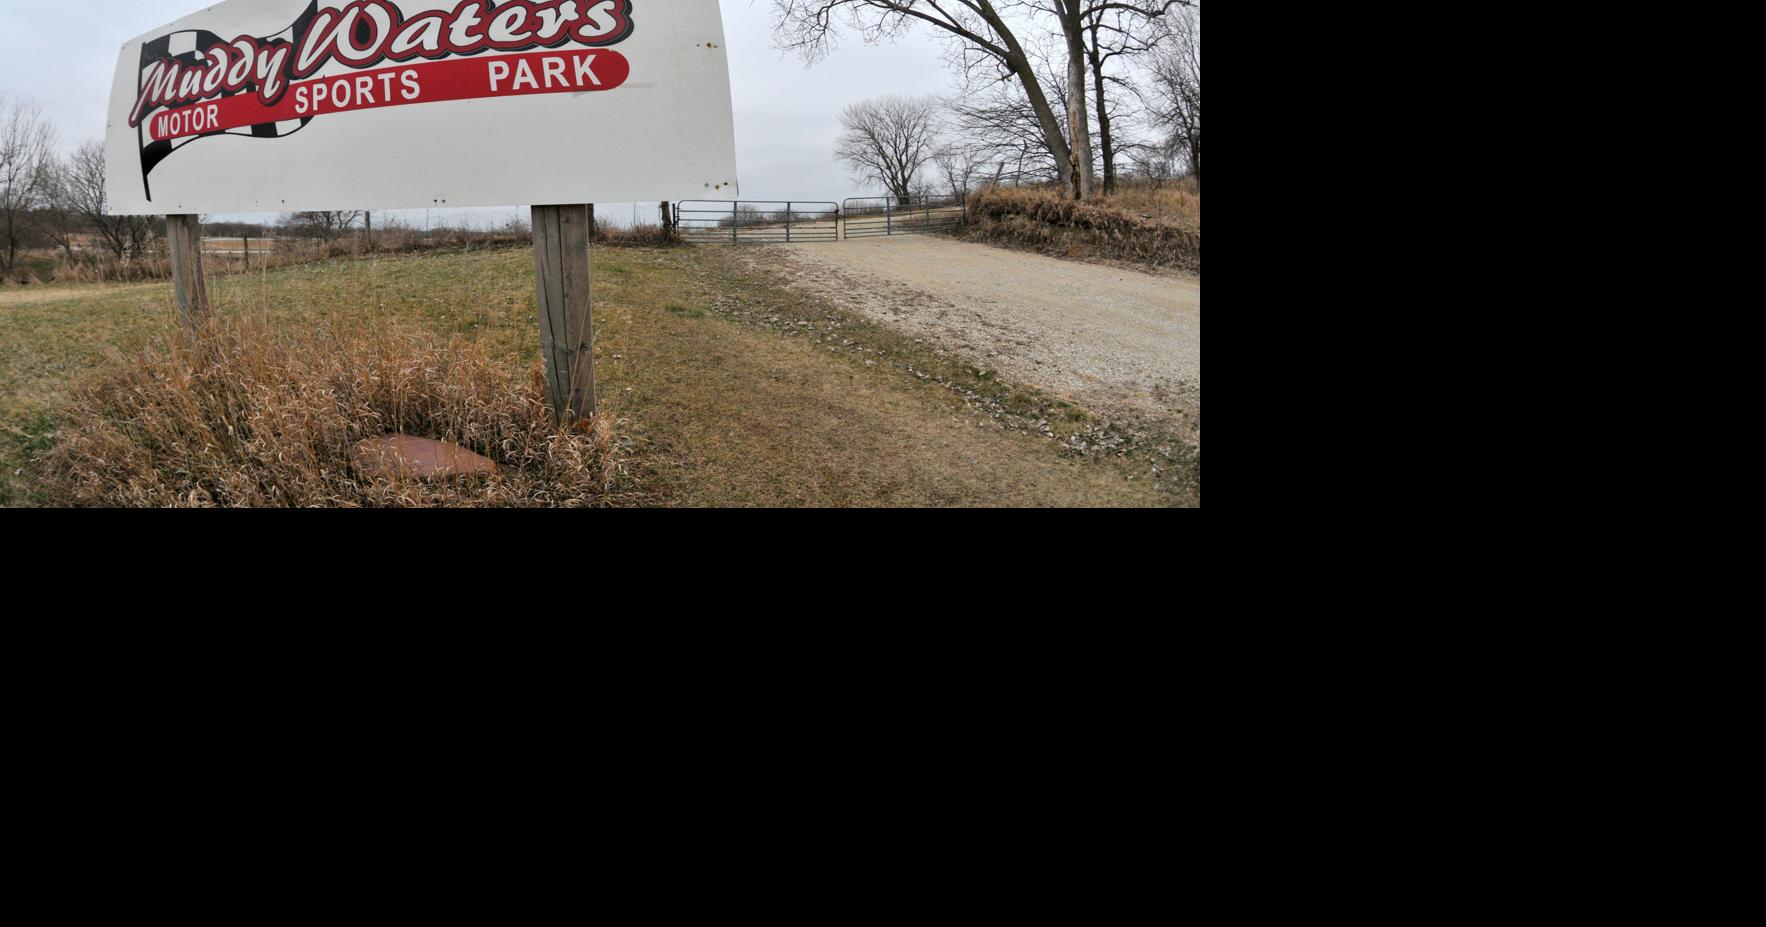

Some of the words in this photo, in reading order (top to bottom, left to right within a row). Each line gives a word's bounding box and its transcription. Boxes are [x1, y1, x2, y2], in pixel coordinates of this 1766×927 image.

[129, 37, 291, 125] Muddy
[295, 0, 627, 76] Waters
[157, 104, 220, 138] MOTOR
[294, 69, 421, 114] SPORTS
[487, 54, 602, 92] PARK
